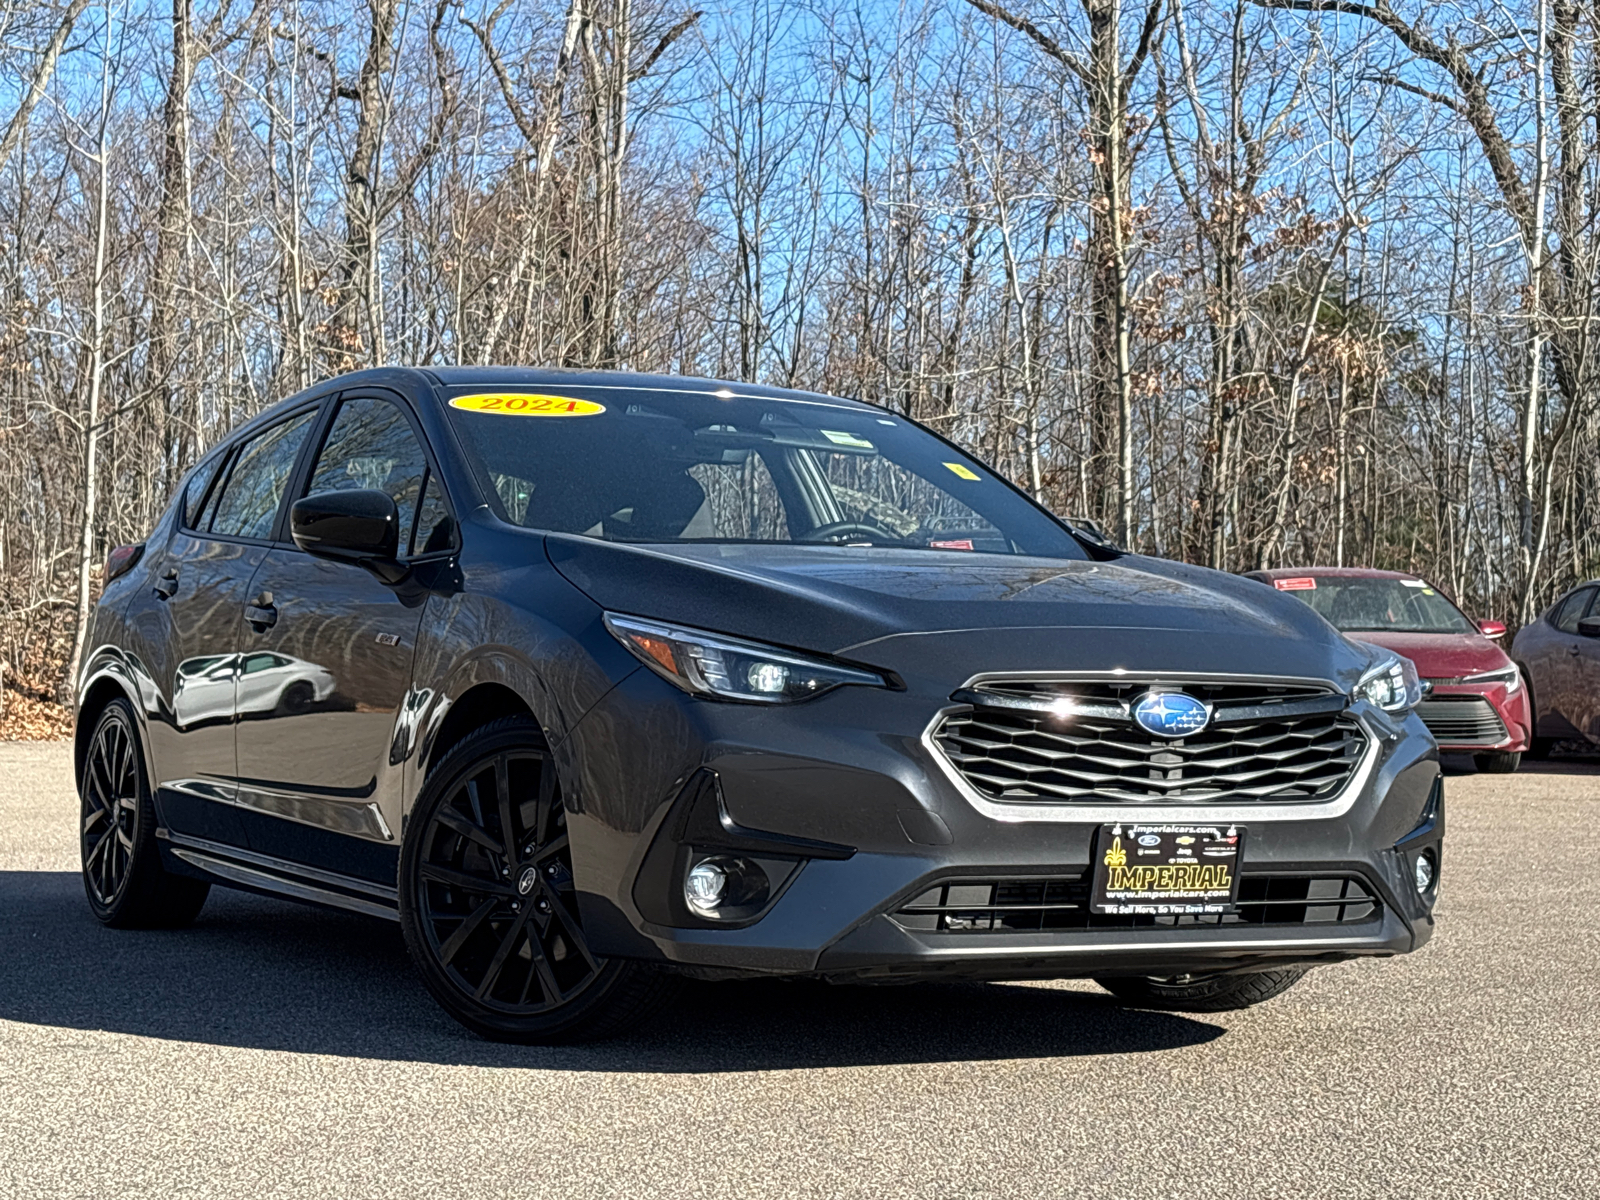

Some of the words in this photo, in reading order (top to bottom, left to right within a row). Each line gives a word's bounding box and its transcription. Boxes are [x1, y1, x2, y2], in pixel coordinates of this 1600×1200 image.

[479, 397, 580, 412] 2024
[1133, 824, 1217, 834] Imperialcars.com
[1107, 865, 1232, 890] IMPERIAL
[1106, 889, 1230, 899] www.imperialcars.com
[1105, 906, 1117, 914] We
[1119, 906, 1133, 914] Sell
[1158, 905, 1168, 913] So
[1169, 904, 1184, 913] You
[1185, 904, 1203, 913] Save
